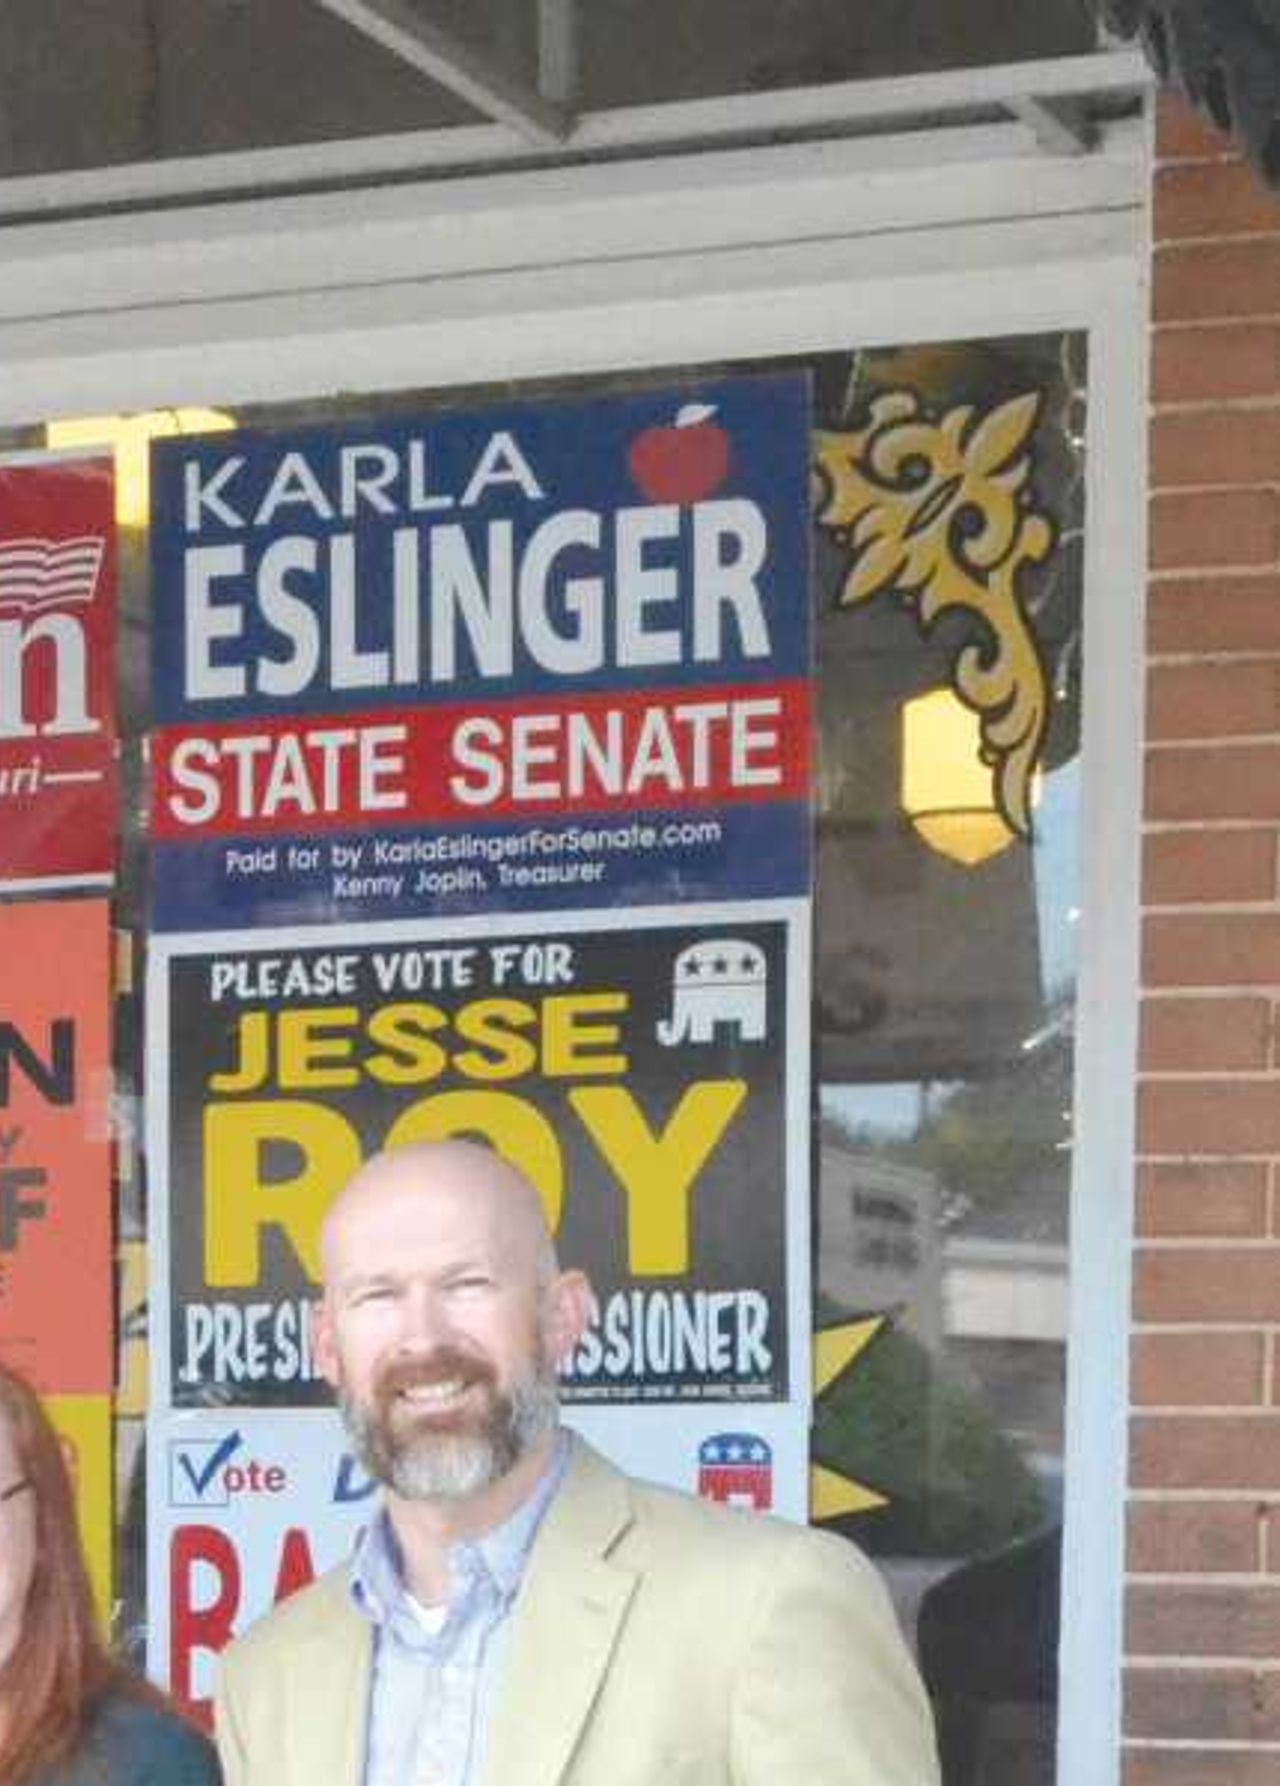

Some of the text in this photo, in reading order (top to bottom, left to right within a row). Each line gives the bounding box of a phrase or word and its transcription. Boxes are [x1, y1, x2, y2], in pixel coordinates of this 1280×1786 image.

[184, 430, 547, 532] KARLA
[183, 497, 772, 700] ESLINGER
[168, 698, 783, 824] STATE SENATE
[226, 819, 722, 875] Paid for by KarlaEslingerForSenate.com
[333, 874, 404, 899] Kenny
[498, 861, 606, 887] Treasurer
[211, 943, 575, 1003] PLEASE VOTE FOR
[207, 991, 631, 1093] JESSE
[178, 1298, 322, 1384] PRESI
[554, 1289, 773, 1377] SSIONER
